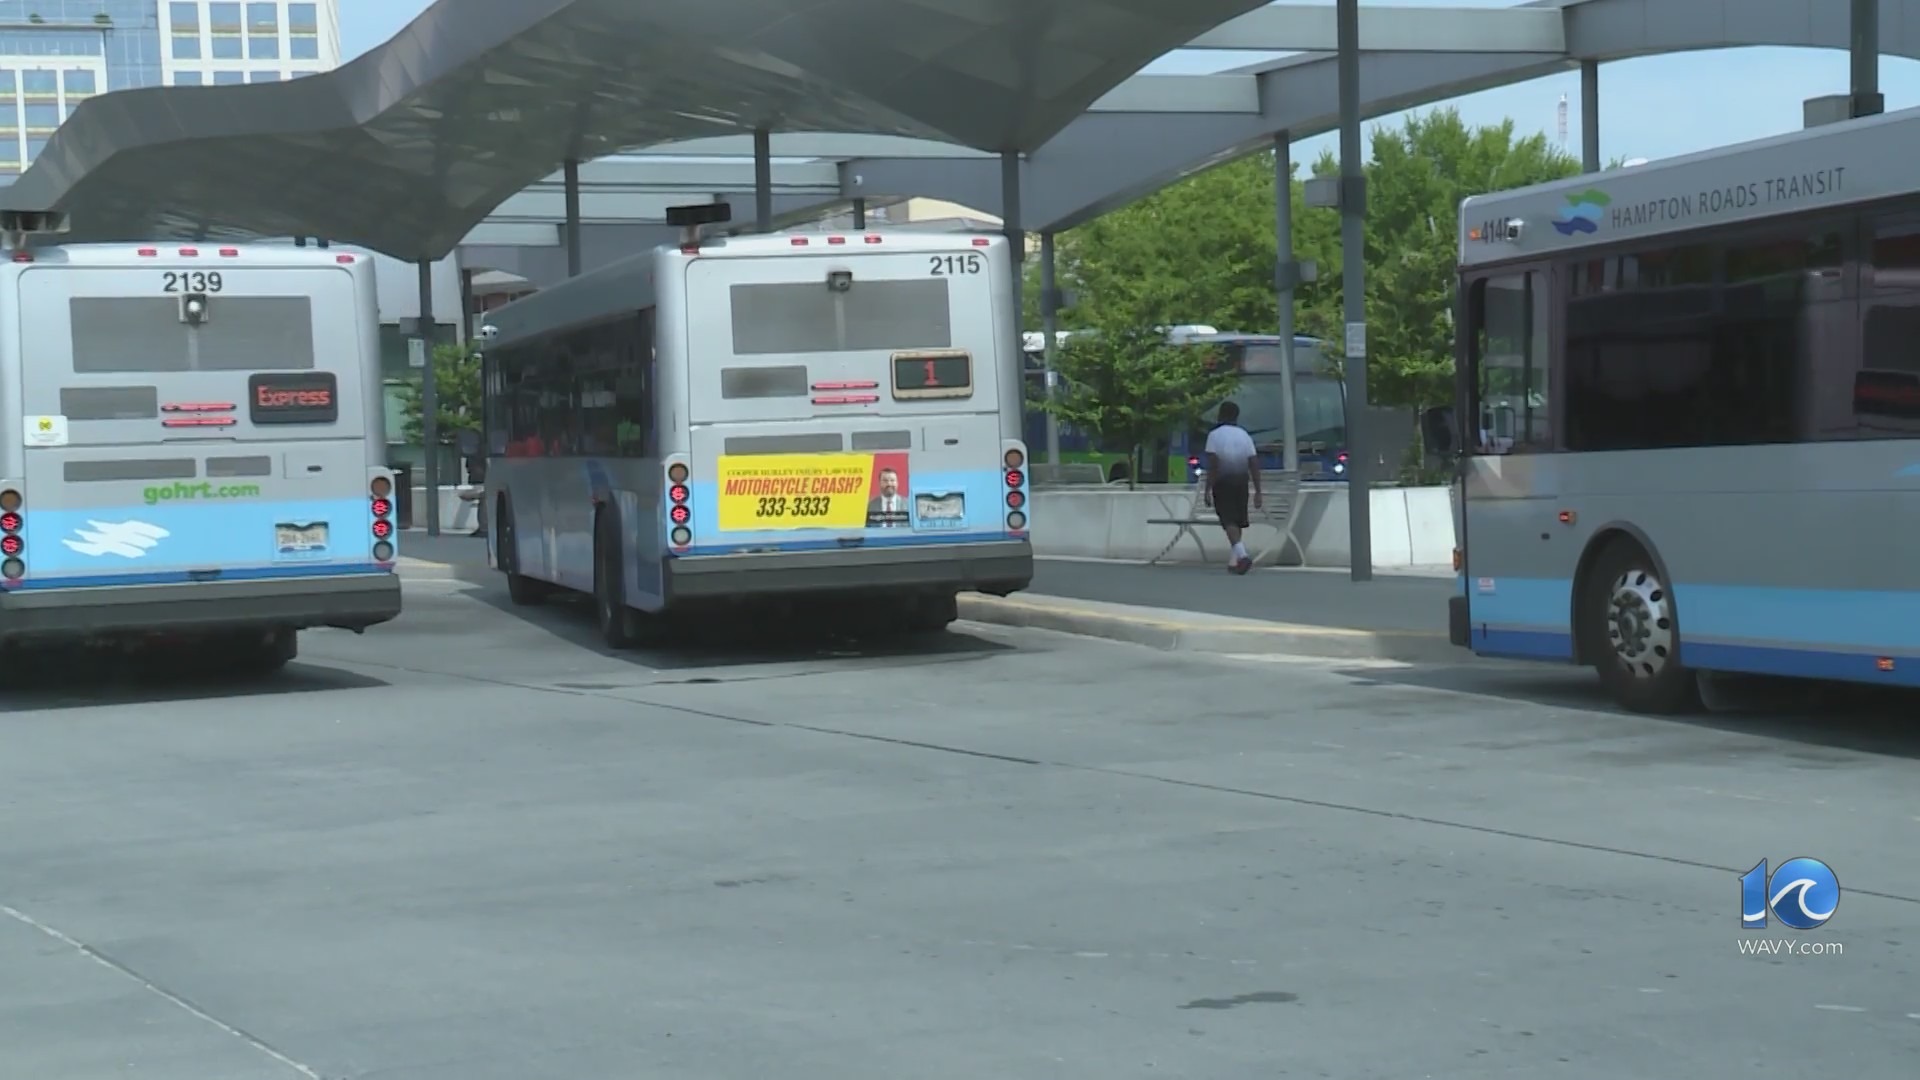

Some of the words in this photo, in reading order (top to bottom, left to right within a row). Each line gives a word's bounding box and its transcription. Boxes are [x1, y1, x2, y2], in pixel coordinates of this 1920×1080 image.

[1612, 195, 1691, 229] HAMPTON
[1700, 183, 1757, 213] ROADS
[1765, 167, 1845, 200] TRANSIT
[929, 255, 980, 276] 2115
[163, 271, 222, 292] 2139
[924, 360, 938, 386] 1
[257, 385, 330, 406] Express
[143, 481, 261, 506] gohrt.com
[725, 477, 810, 496] MOTORCYCLE
[811, 476, 863, 495] CRASH?
[756, 496, 831, 518] 333-3333
